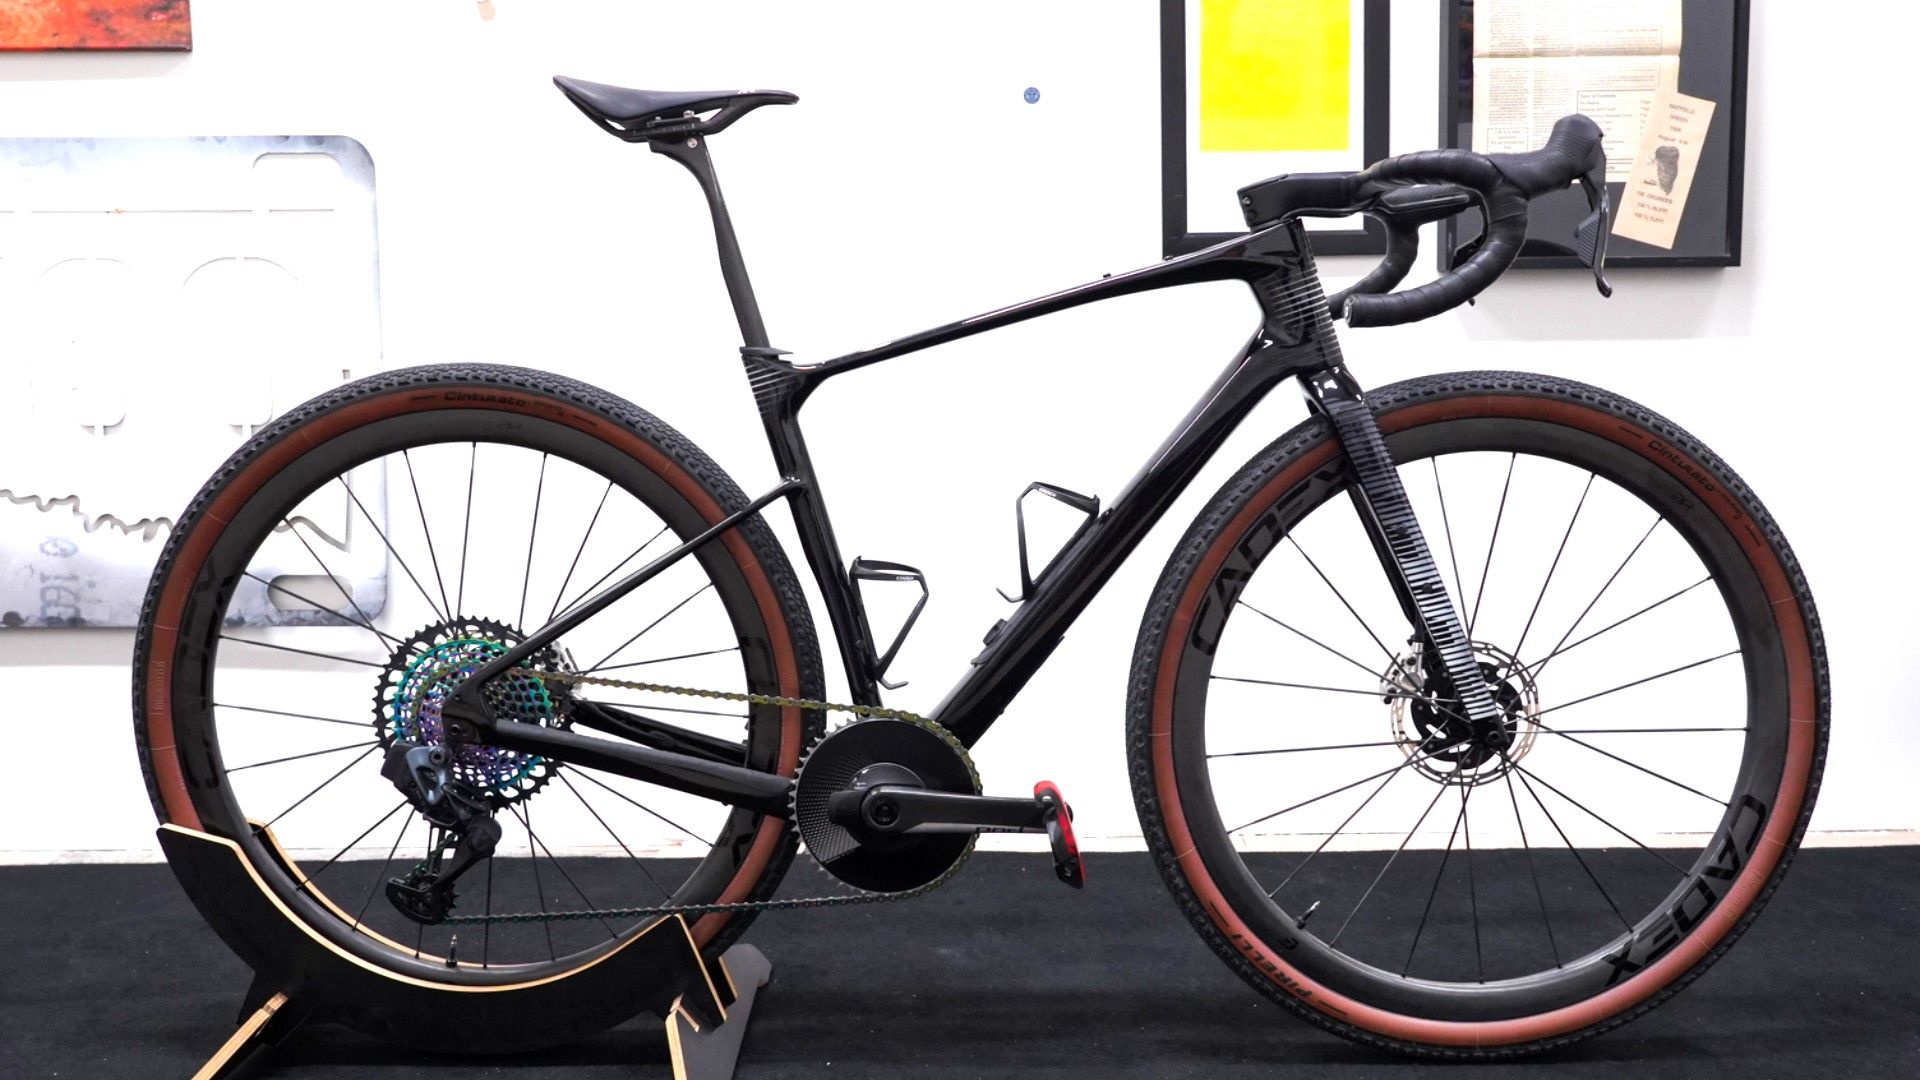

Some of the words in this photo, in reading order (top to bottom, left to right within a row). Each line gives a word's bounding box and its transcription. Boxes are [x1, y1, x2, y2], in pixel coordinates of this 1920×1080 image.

[443, 391, 526, 407] Cinturato
[1647, 440, 1715, 492] Cinturato
[1191, 457, 1352, 656] CADEX
[1604, 794, 1766, 987] CADEX
[1231, 933, 1313, 998] PIRELLI
